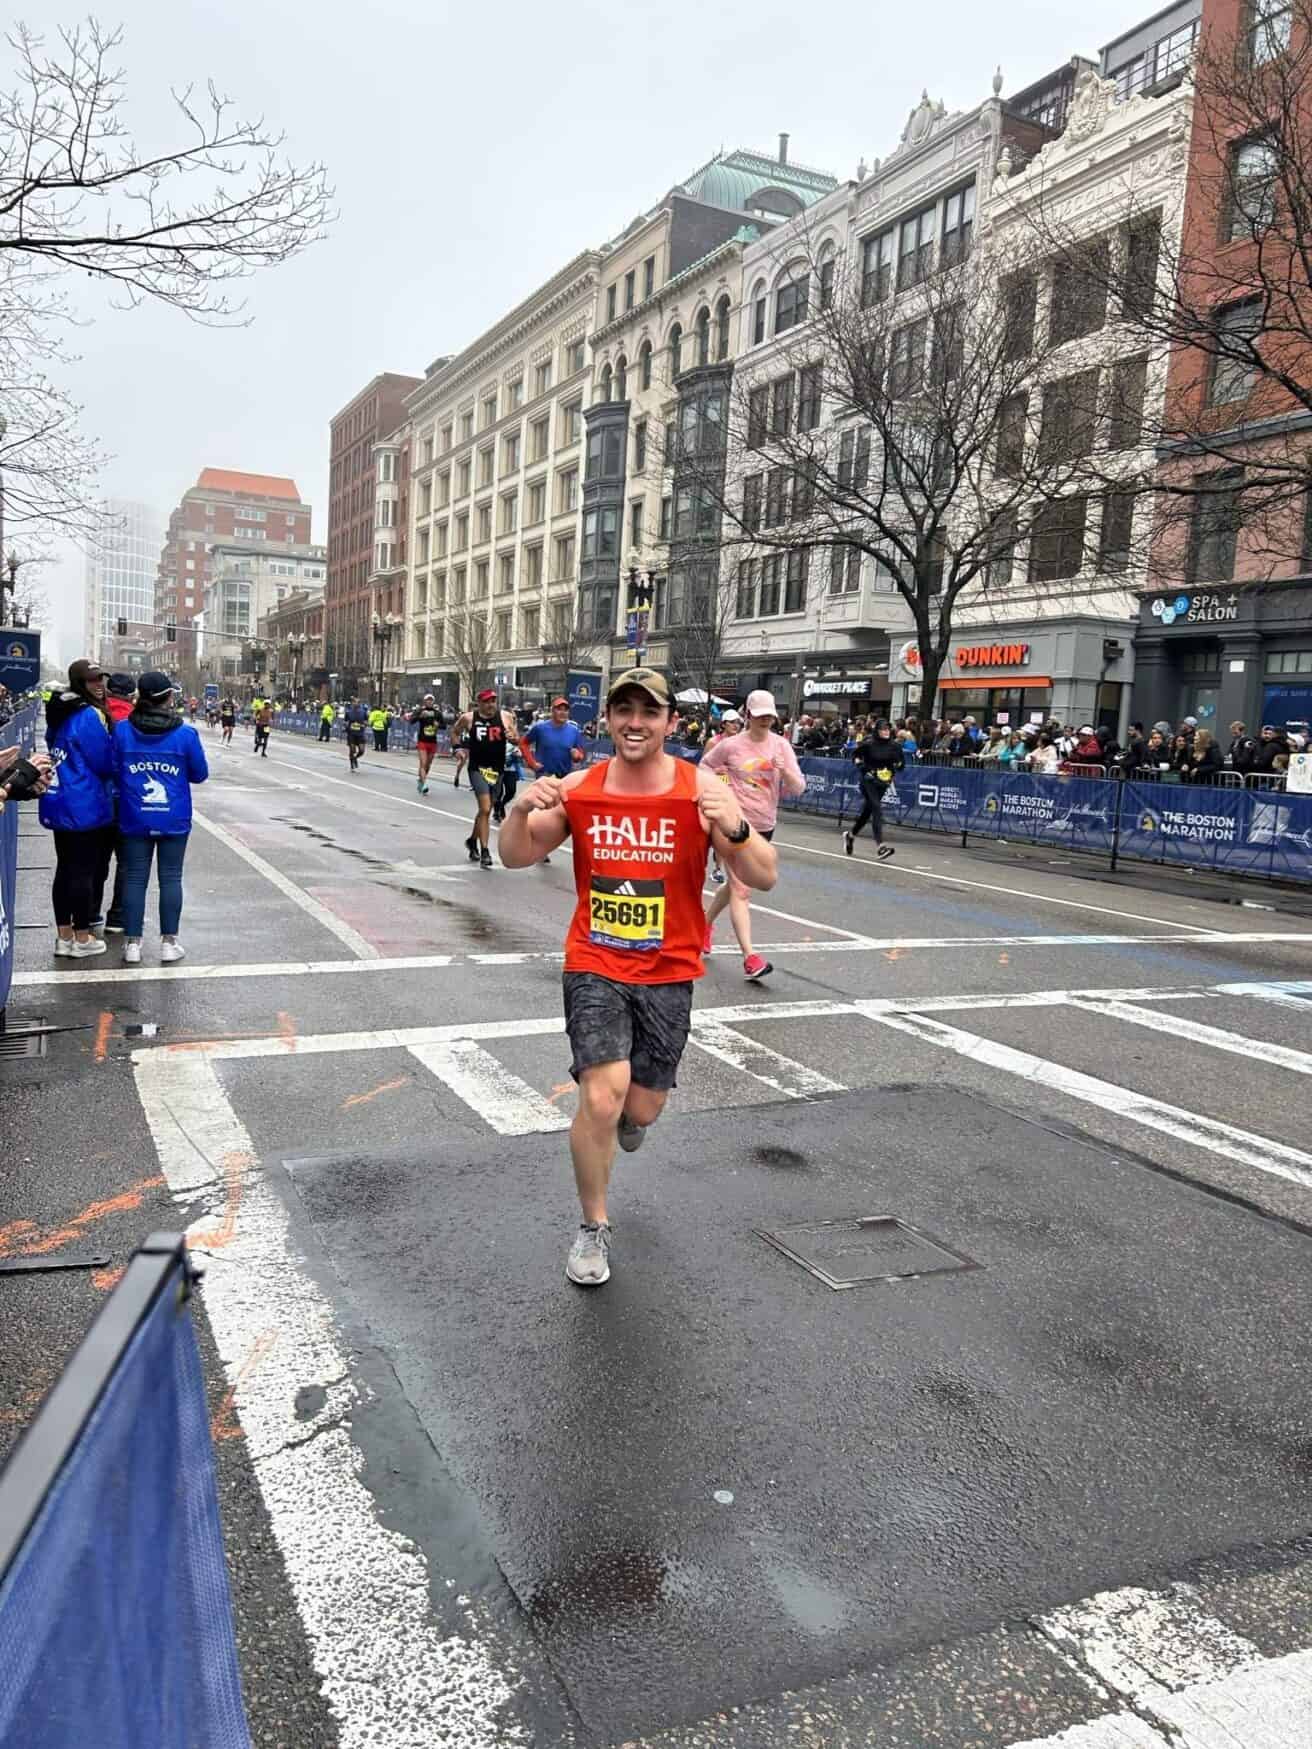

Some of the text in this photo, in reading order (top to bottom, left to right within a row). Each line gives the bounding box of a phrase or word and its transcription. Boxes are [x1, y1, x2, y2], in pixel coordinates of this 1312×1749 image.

[1192, 594, 1219, 609] SPA
[1187, 606, 1237, 622] SALON
[956, 642, 1029, 666] DUNKIN'
[129, 761, 180, 777] BOSTON
[1004, 794, 1054, 808] THE BOSTON
[1002, 804, 1053, 819] MARATHON
[1163, 811, 1235, 828] THE BOSTON
[587, 814, 677, 849] HALE
[1161, 823, 1234, 841] MARATHON
[593, 848, 674, 863] EDUCATION
[591, 897, 660, 927] 25691
